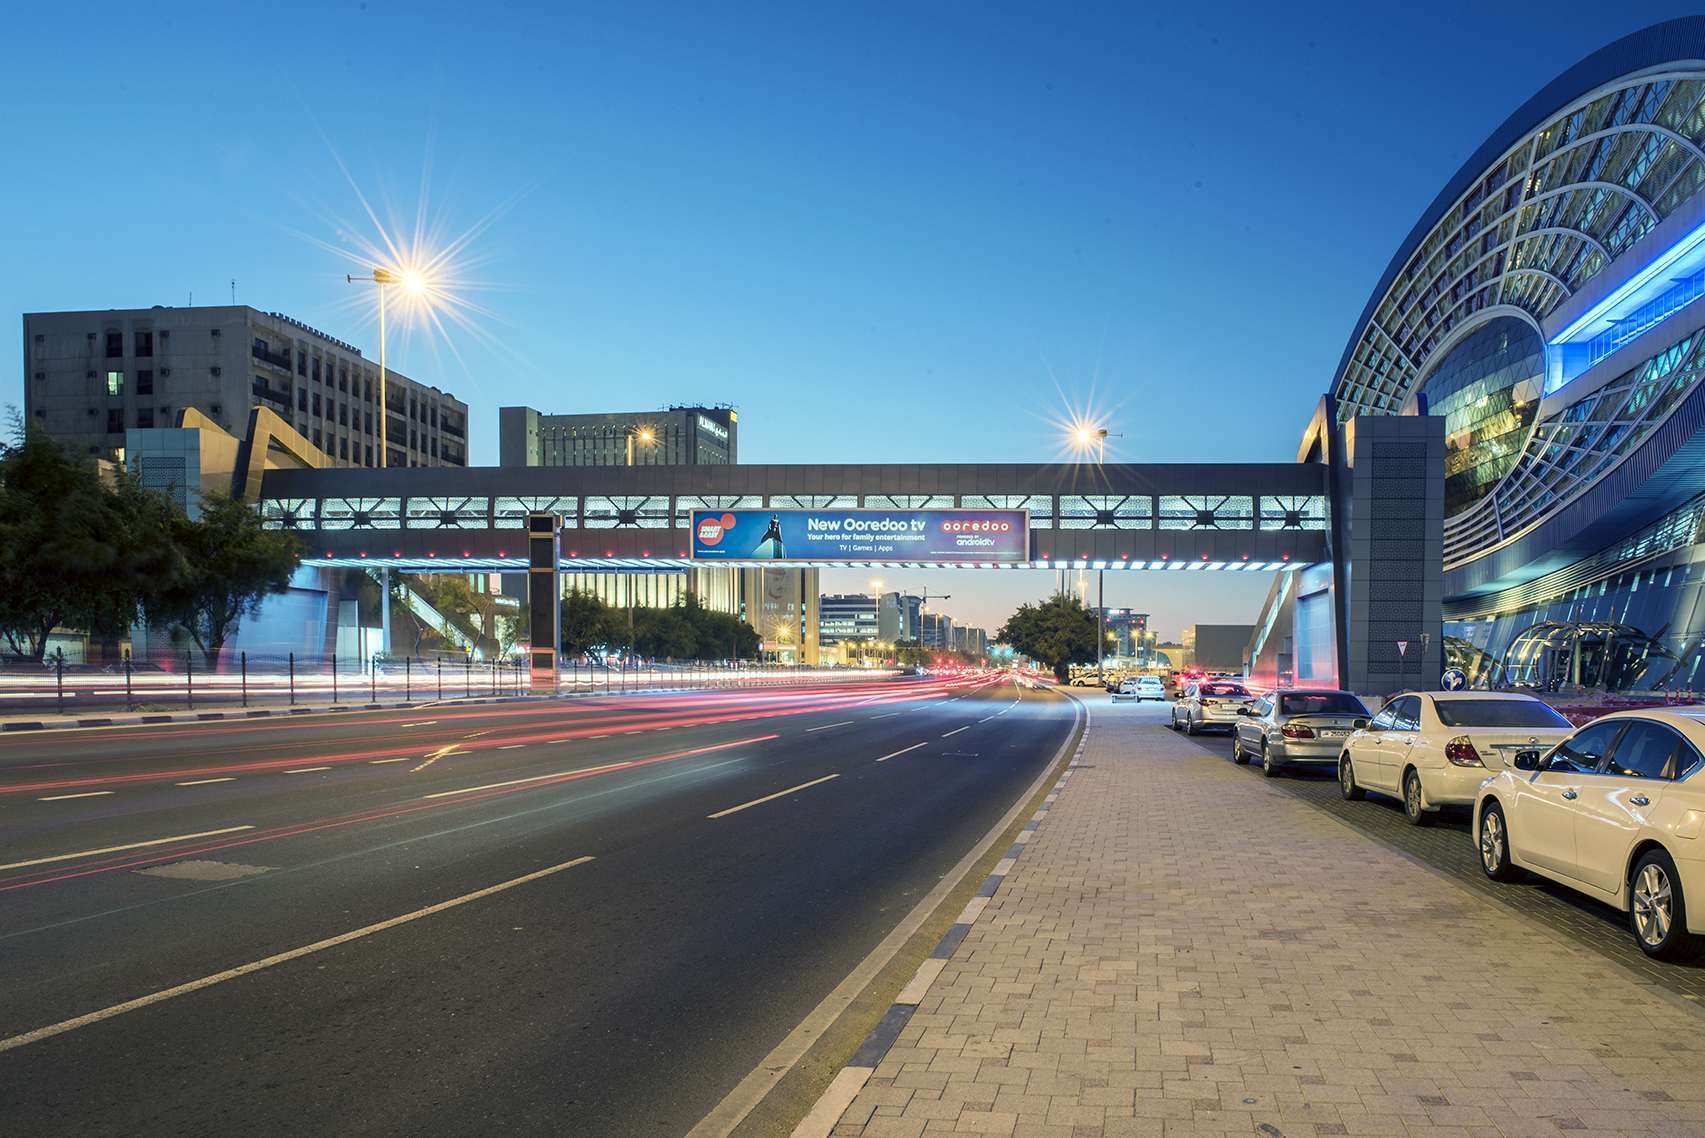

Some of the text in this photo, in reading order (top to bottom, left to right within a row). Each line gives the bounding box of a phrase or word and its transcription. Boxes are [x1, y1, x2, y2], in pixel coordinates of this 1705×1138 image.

[808, 518, 926, 531] New Ooredoo tv
[943, 520, 1009, 531] ooredoo
[807, 533, 926, 542] Your hero for family entertainment
[878, 544, 894, 552] Apps
